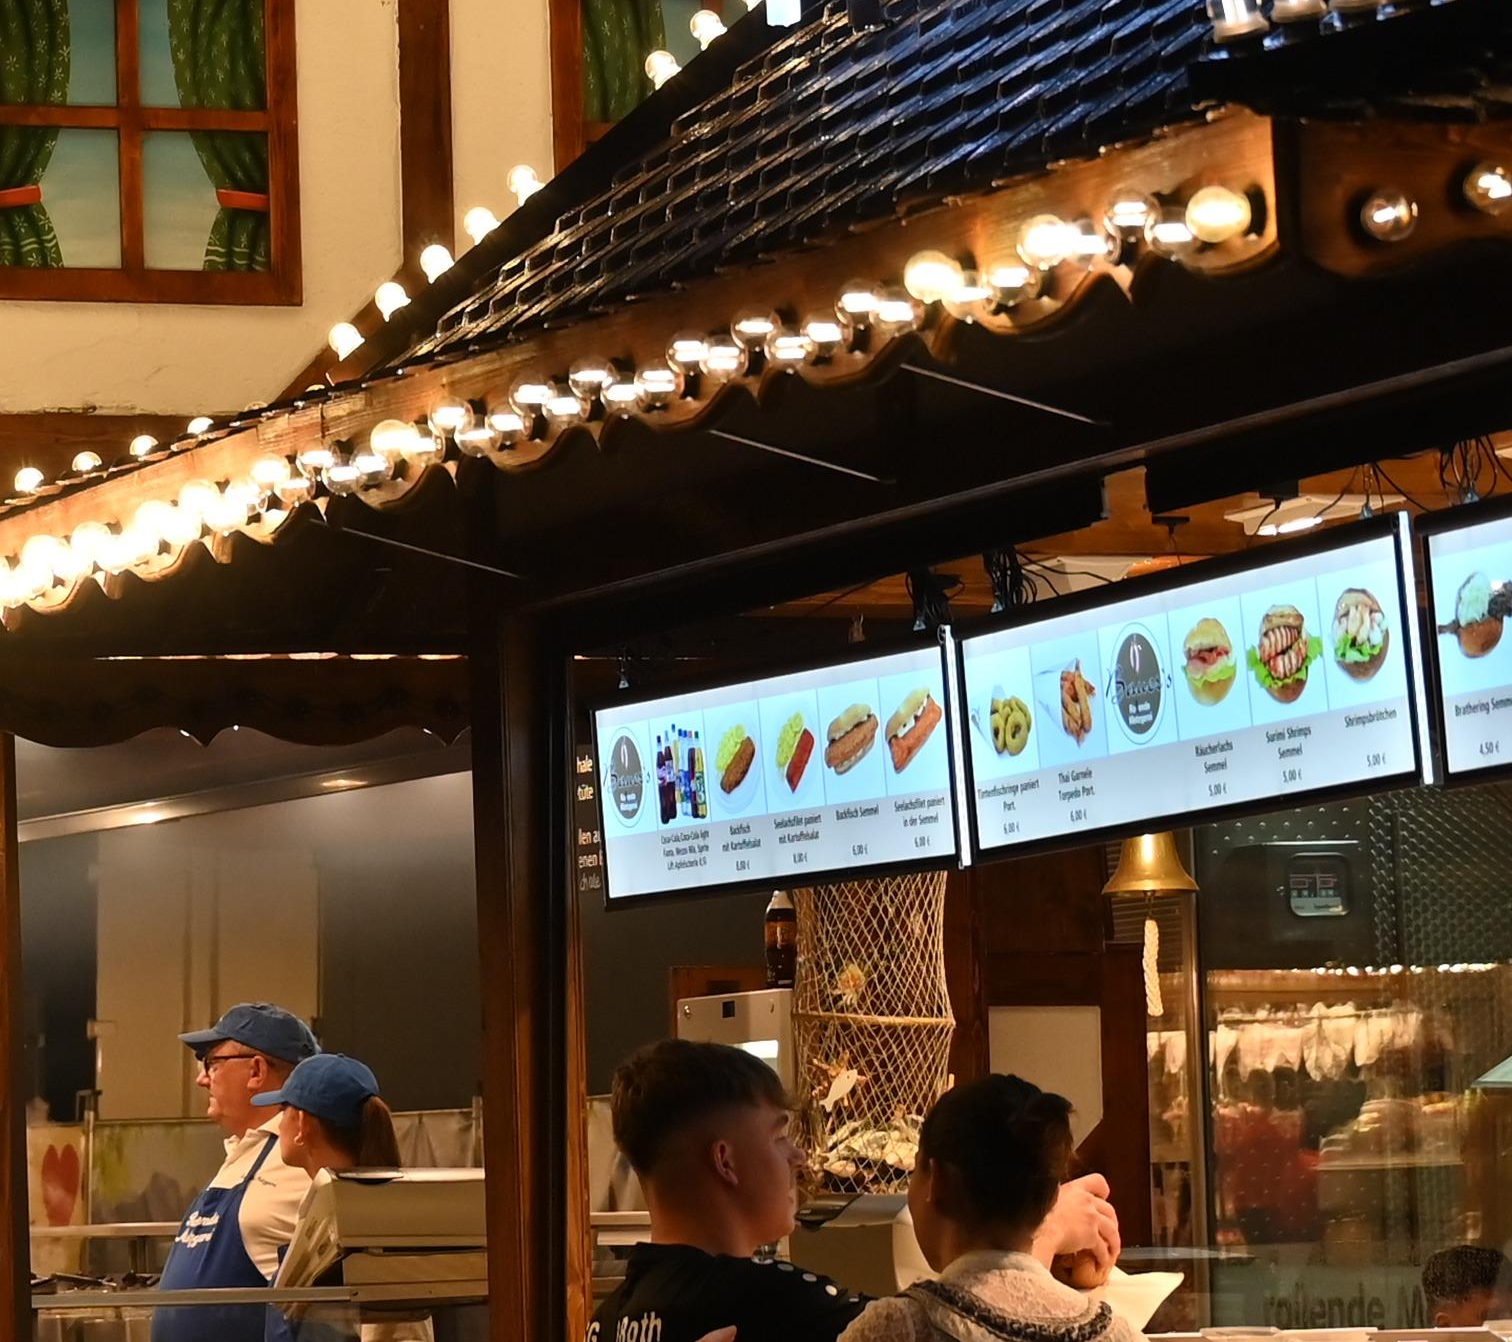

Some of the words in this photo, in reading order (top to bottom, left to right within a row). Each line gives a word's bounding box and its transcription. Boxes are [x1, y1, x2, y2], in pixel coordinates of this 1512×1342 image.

[1344, 707, 1397, 728] Shrimpsbrötchen
[1455, 700, 1490, 717] Brathering
[1266, 730, 1285, 743] Surimi
[1287, 724, 1311, 740] Shrimps
[1278, 743, 1302, 759] Semmel
